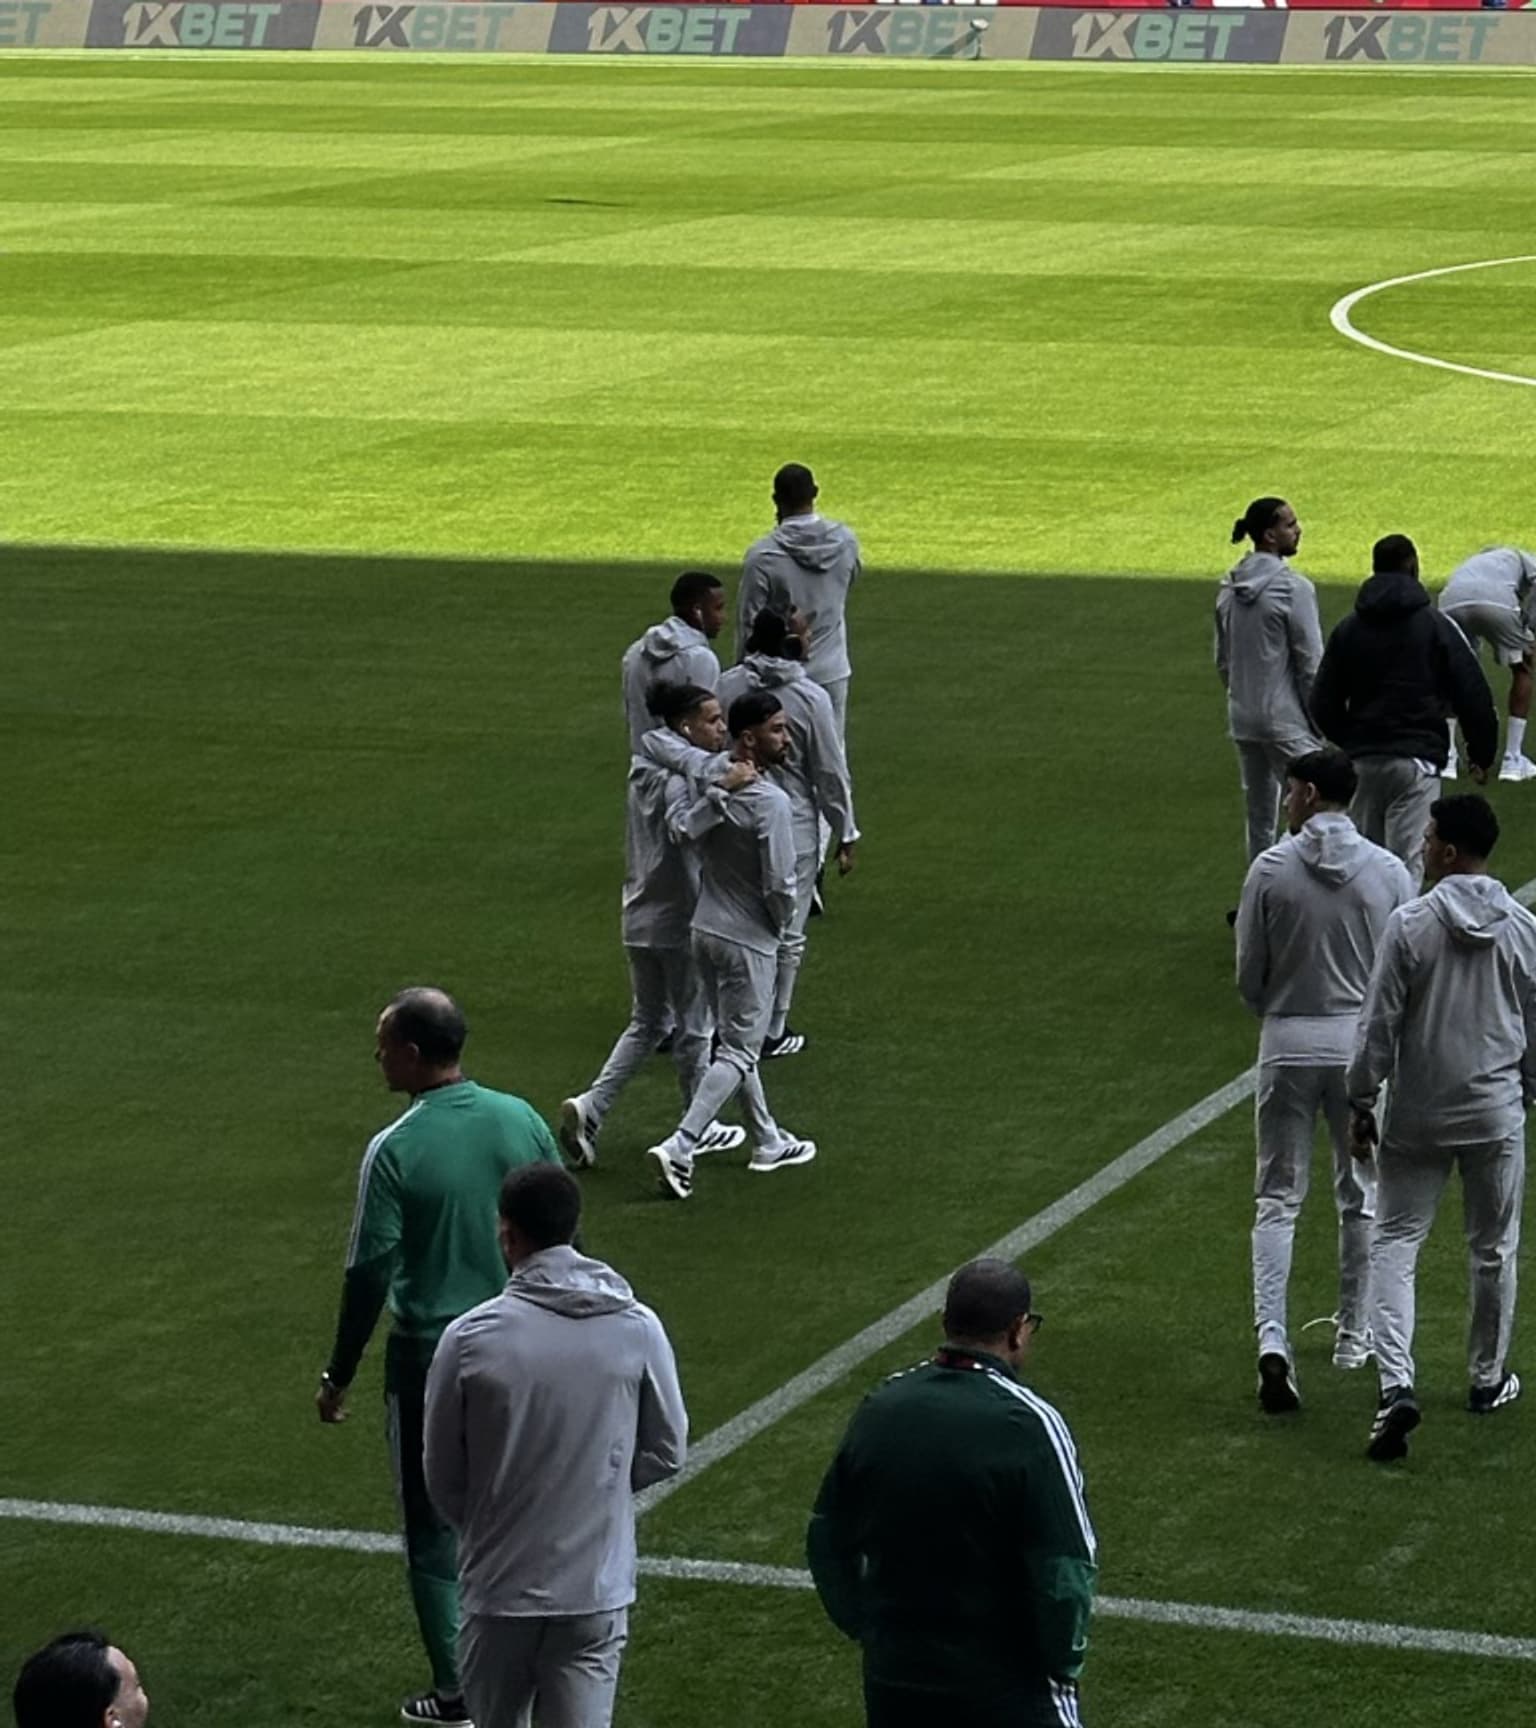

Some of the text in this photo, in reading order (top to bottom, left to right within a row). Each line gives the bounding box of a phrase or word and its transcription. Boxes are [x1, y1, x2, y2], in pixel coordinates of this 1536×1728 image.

[122, 3, 281, 47] 1XBET
[352, 5, 514, 49] 1XBET
[587, 7, 752, 53] 1XBET
[1072, 13, 1245, 60] 1XBET
[1324, 15, 1499, 61] 1XBET
